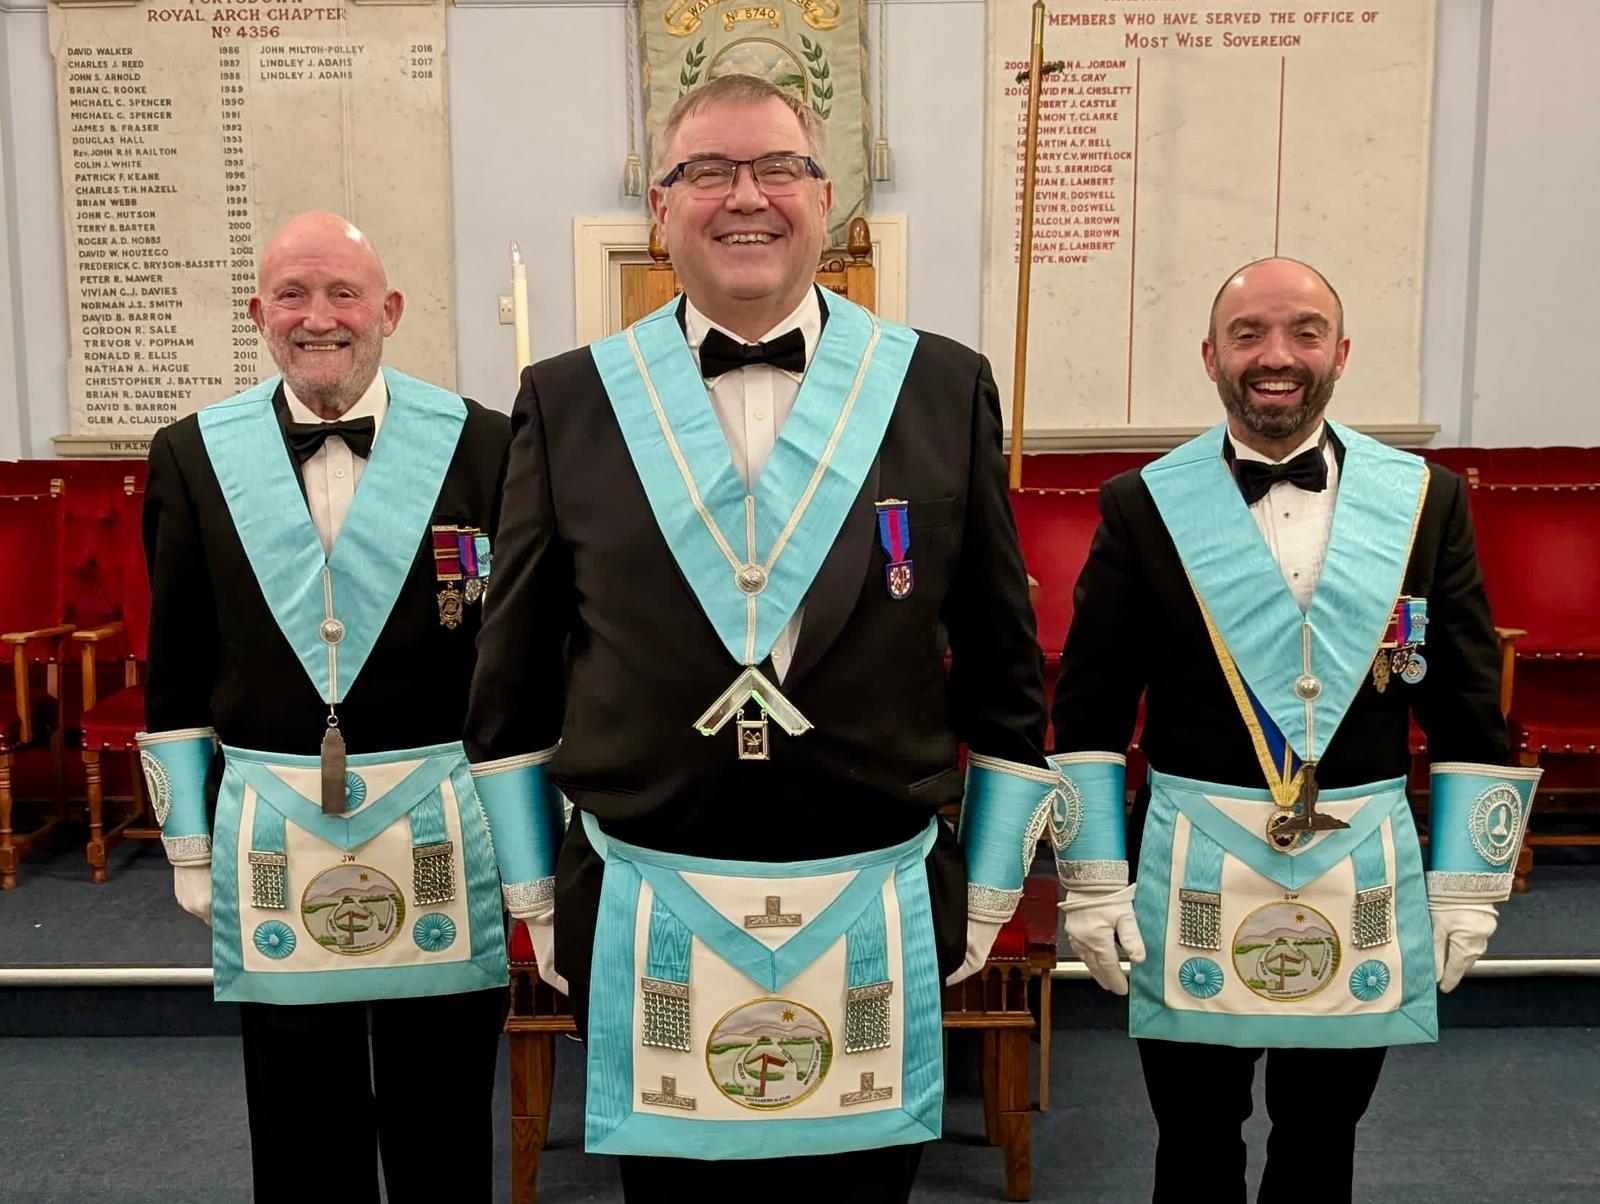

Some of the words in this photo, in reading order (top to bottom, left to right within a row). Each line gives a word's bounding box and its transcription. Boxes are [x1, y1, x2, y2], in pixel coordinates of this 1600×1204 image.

[148, 9, 204, 22] ROYAL
[213, 9, 260, 21] ARCH
[267, 8, 346, 20] CHAPTER
[745, 8, 776, 19] 5740
[1050, 14, 1116, 25] MEMBERS
[1124, 14, 1155, 25] WHO
[1164, 13, 1198, 24] HAVE
[1206, 12, 1261, 24] SERVED
[1269, 12, 1295, 24] THE
[1304, 12, 1354, 23] OFFICE
[1362, 12, 1378, 23] OF
[236, 26, 280, 38] 4356
[260, 59, 303, 67] LINDLEY
[1040, 74, 1059, 82] AVID
[1081, 74, 1106, 82] GRAY
[1087, 87, 1132, 95] CHISLETT
[1038, 100, 1066, 108] OBERT
[1037, 140, 1067, 148] ARTIN
[1080, 152, 1132, 160] WHITELOCK
[1035, 178, 1058, 186] RIAN
[1070, 178, 1114, 186] LAMBERT
[1070, 242, 1115, 250] LAMBERT
[144, 261, 227, 269] BRYSON-BASSETT
[81, 289, 116, 297] VIVIAN
[83, 327, 131, 335] GORDON
[135, 390, 191, 398] DAUBENEY
